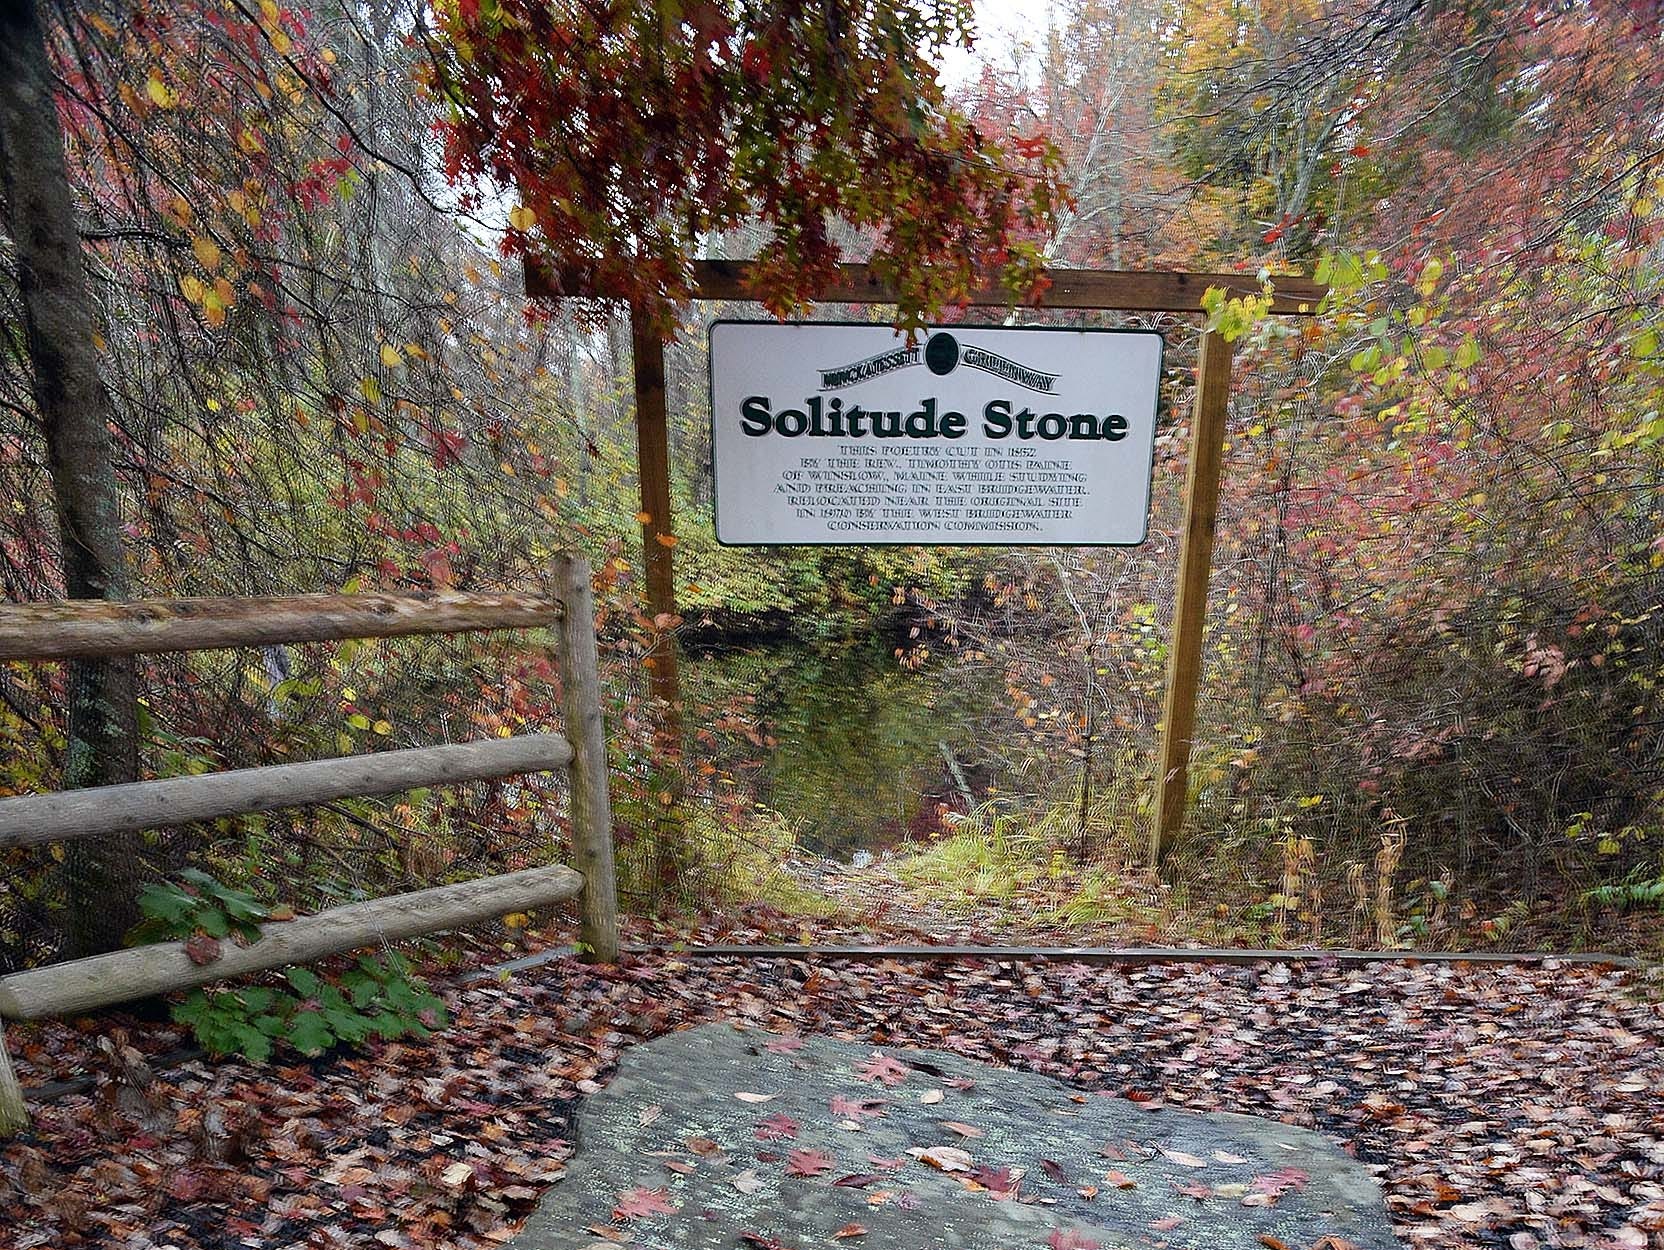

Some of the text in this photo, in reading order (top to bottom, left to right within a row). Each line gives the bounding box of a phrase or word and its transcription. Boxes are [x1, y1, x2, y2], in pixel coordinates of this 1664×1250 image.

[963, 348, 1057, 391] GREENWAY
[741, 397, 1130, 441] Solitude Stone
[839, 446, 876, 456] THIS
[882, 446, 941, 456] POETRY
[945, 446, 978, 456] CUT
[984, 447, 1003, 457] IN
[800, 458, 821, 468] BY
[825, 458, 859, 469] THE
[906, 459, 981, 469] TIMOTHY
[985, 460, 1022, 469] OTIS
[1026, 460, 1072, 470] PAINE
[782, 471, 802, 481] OF
[894, 472, 948, 482] MAINE
[952, 472, 1006, 482] WHILE
[1009, 473, 1087, 483] STUDYING
[774, 484, 811, 493] AND
[815, 484, 906, 494] PREACHING
[912, 484, 931, 494] IN
[936, 485, 973, 494] EAST
[787, 496, 1082, 507] RELOCATED NEAR THE ORIGINAL SITE
[796, 508, 815, 518] IN
[856, 509, 877, 518] BY
[880, 509, 913, 518] THE
[918, 509, 961, 519] WEST
[966, 509, 1073, 519] BRIDGEWATER
[827, 521, 1044, 532] CONSERVATION COMMISSION.
